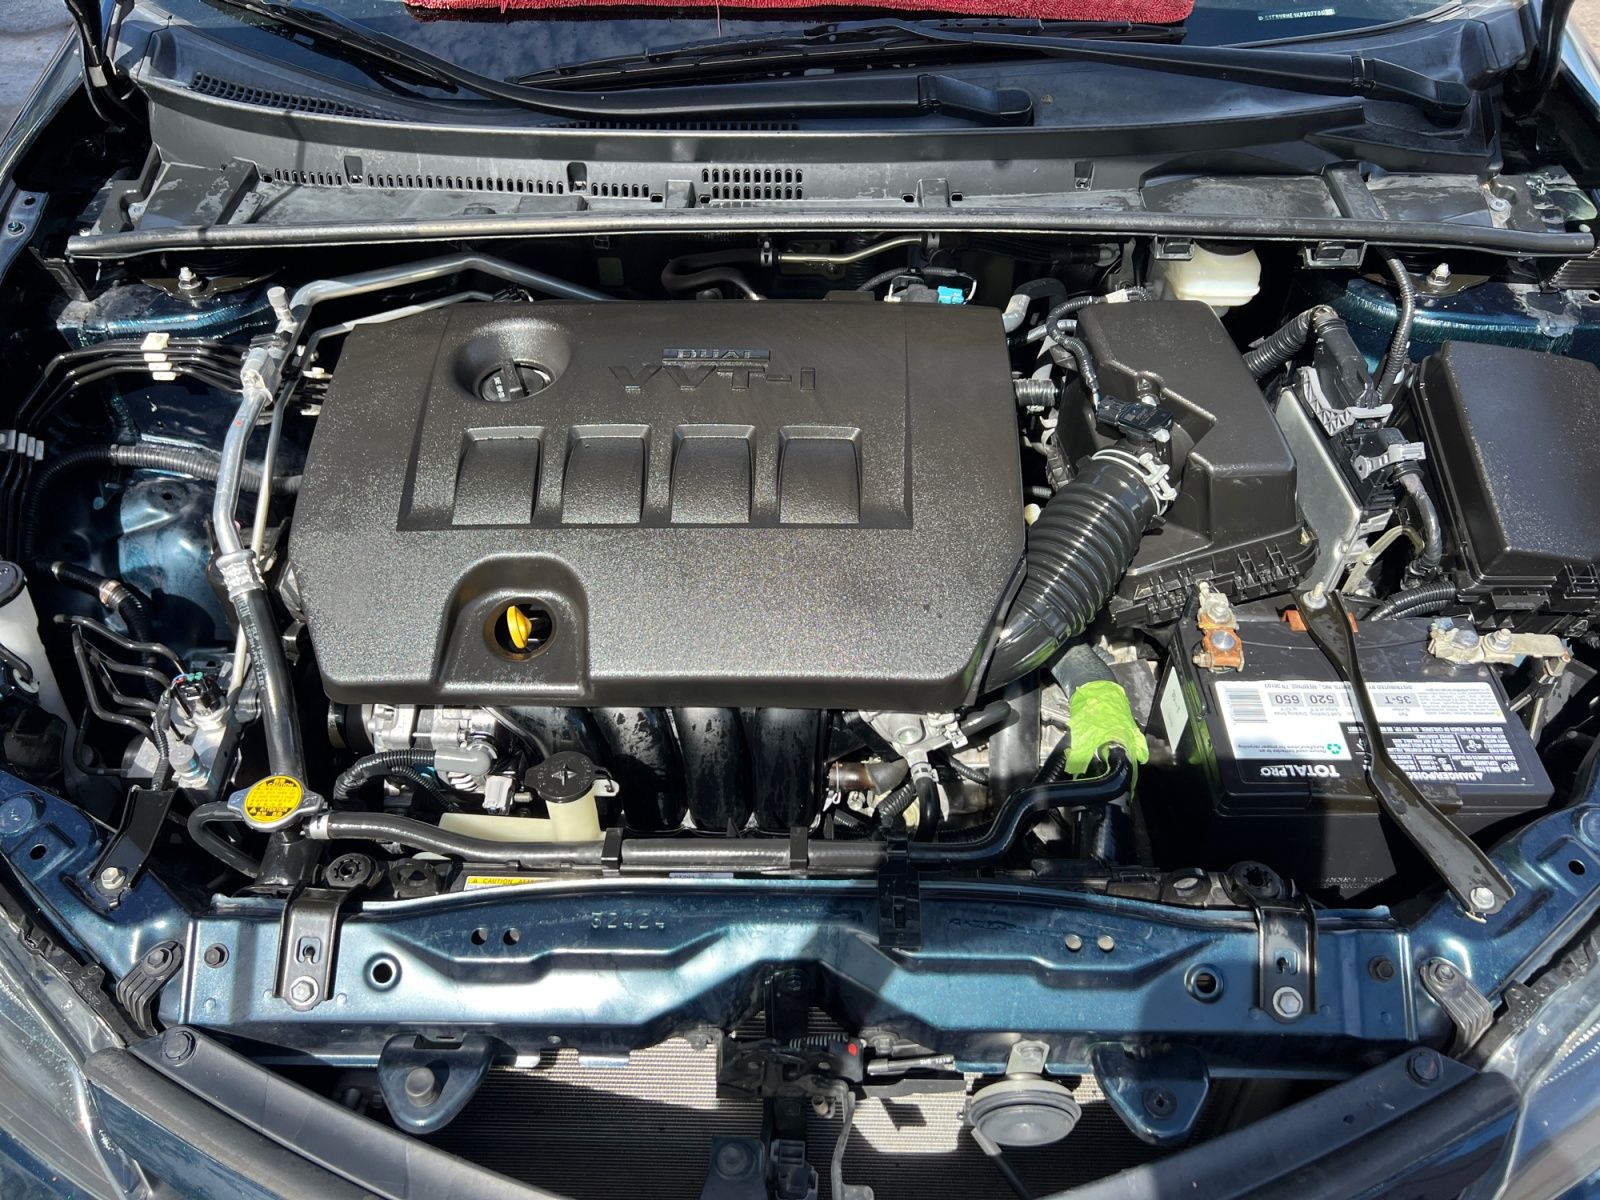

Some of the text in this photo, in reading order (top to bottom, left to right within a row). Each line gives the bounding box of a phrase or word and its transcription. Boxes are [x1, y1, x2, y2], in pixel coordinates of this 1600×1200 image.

[1273, 694, 1300, 703] 650
[1308, 695, 1335, 703] 520
[1381, 695, 1412, 704] 35-T
[1258, 764, 1340, 777] TOTALPRO
[1404, 771, 1477, 780] DANGER/POISO
